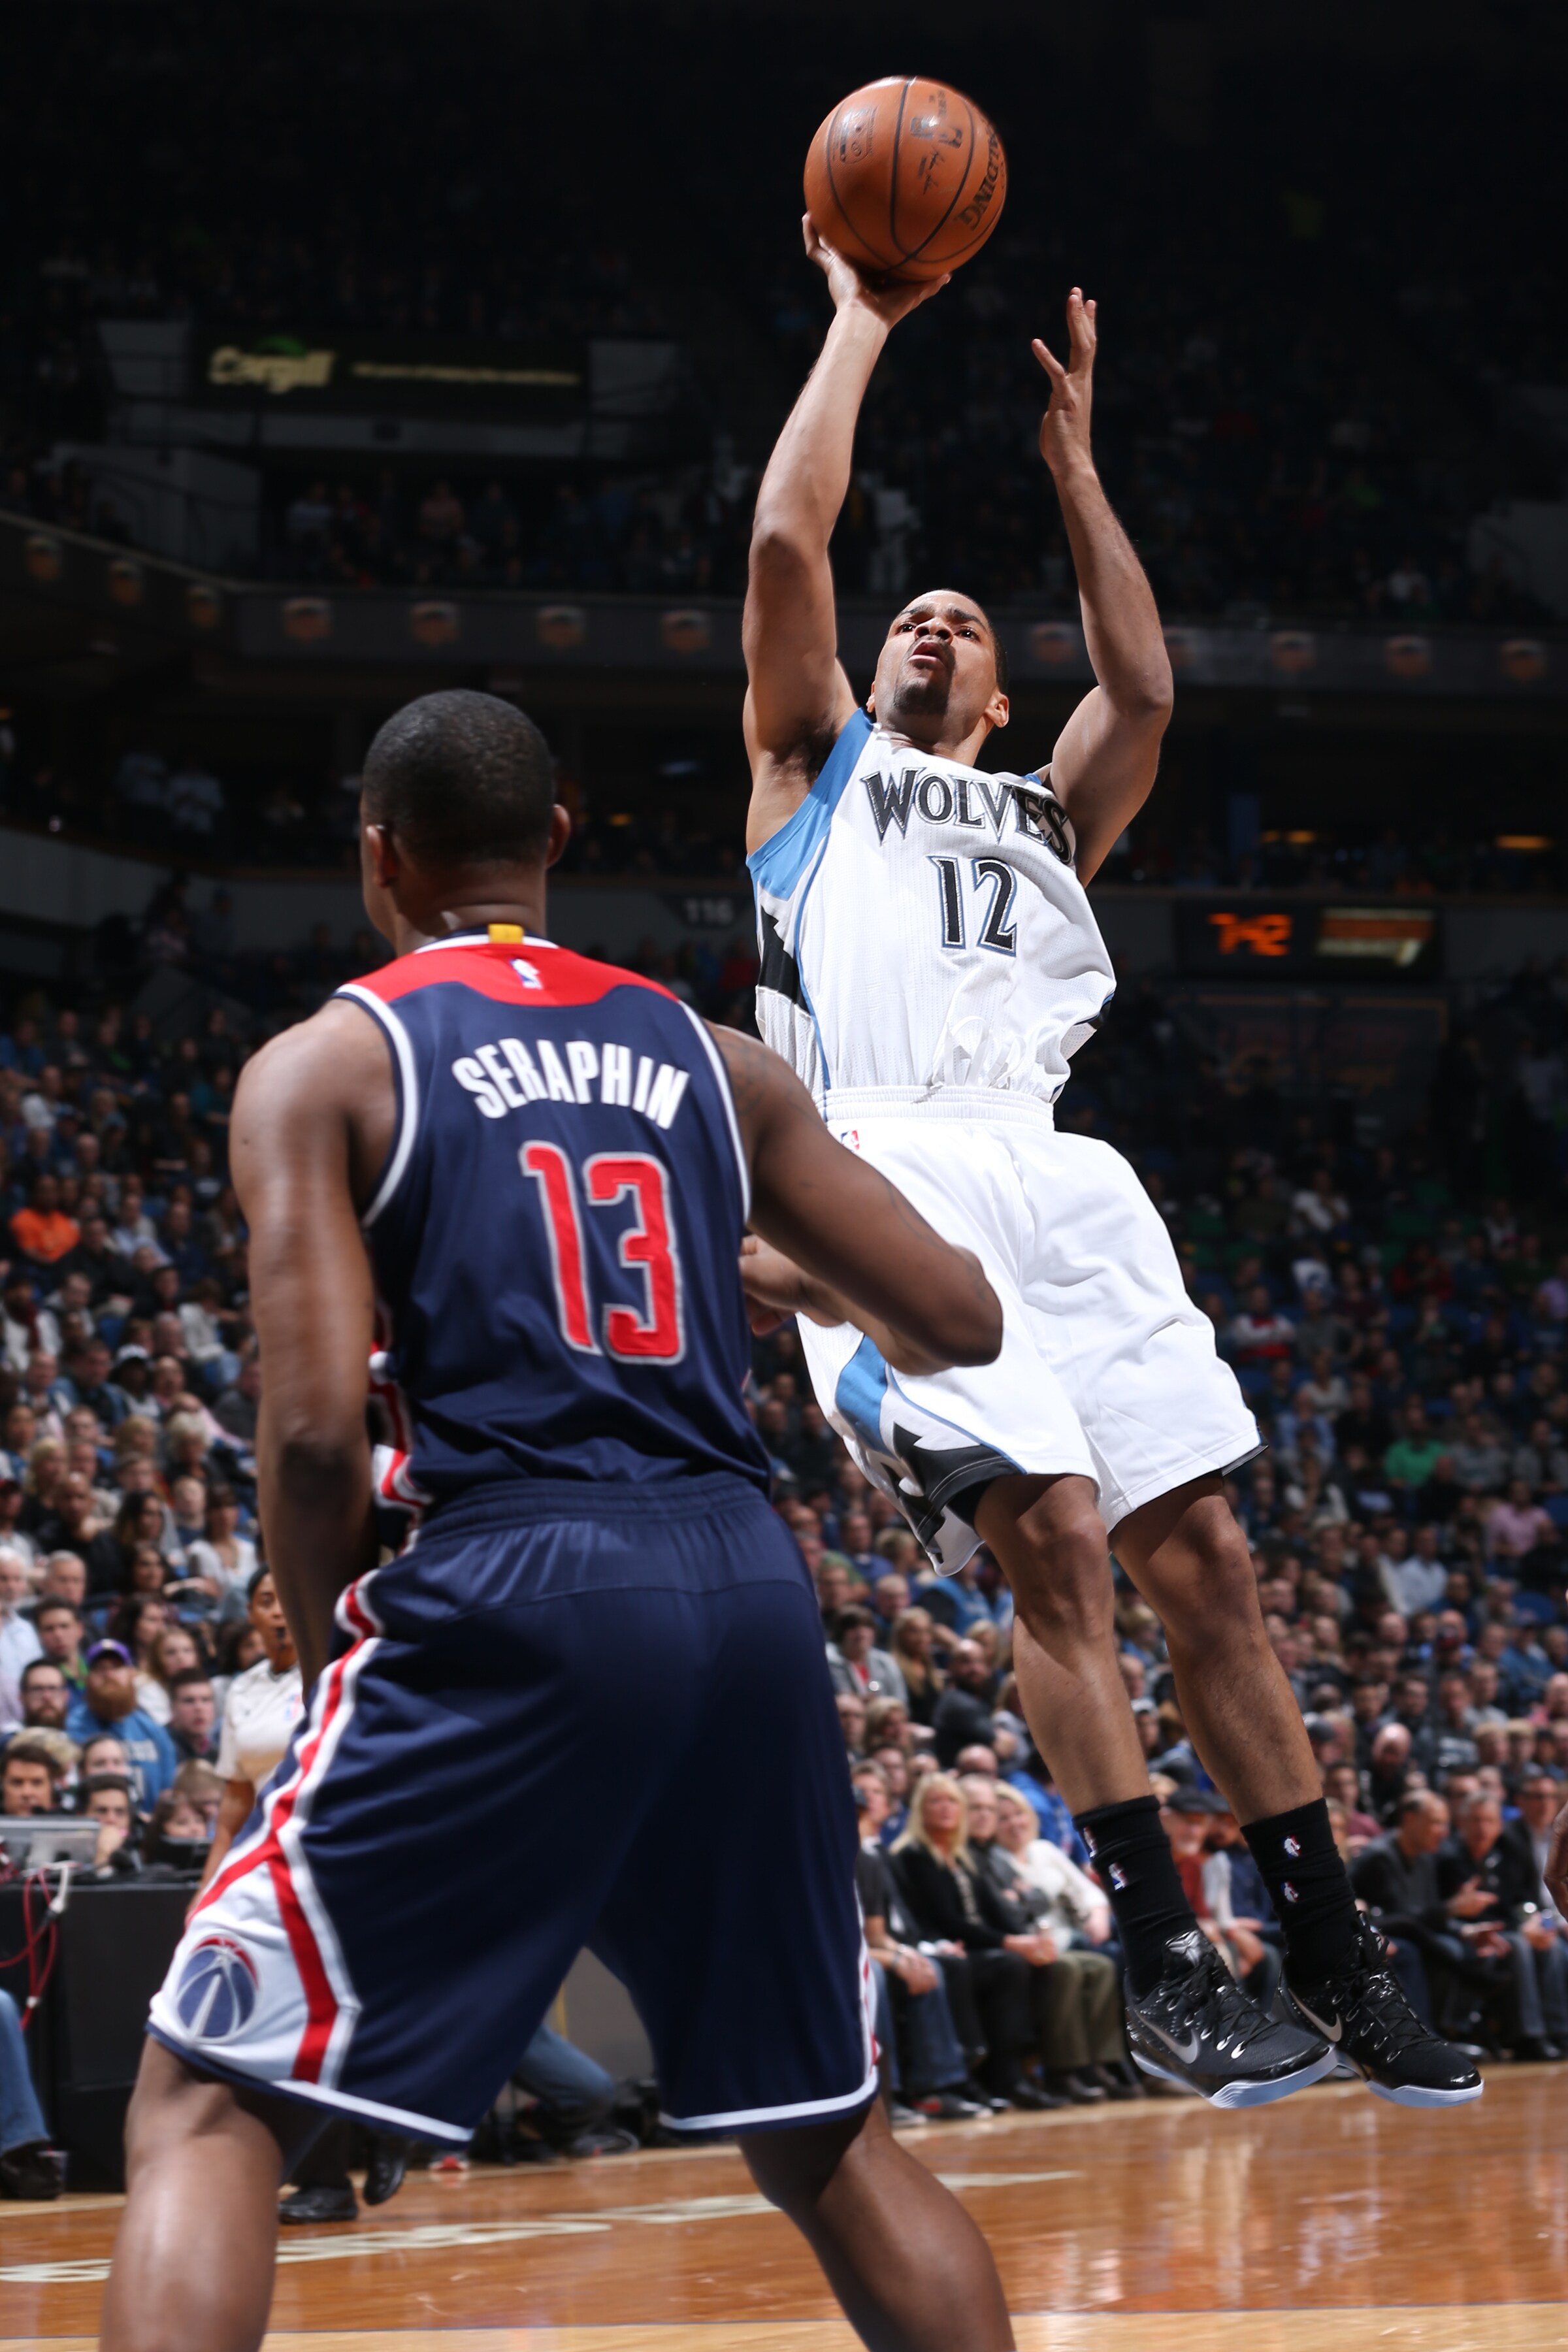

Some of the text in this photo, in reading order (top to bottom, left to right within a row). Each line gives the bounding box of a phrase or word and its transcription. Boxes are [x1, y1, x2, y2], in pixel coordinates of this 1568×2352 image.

[860, 767, 1073, 866] WOLVES
[925, 855, 1017, 957] 12
[451, 1037, 689, 1130] SERAPHIN
[518, 1139, 686, 1365] 13
